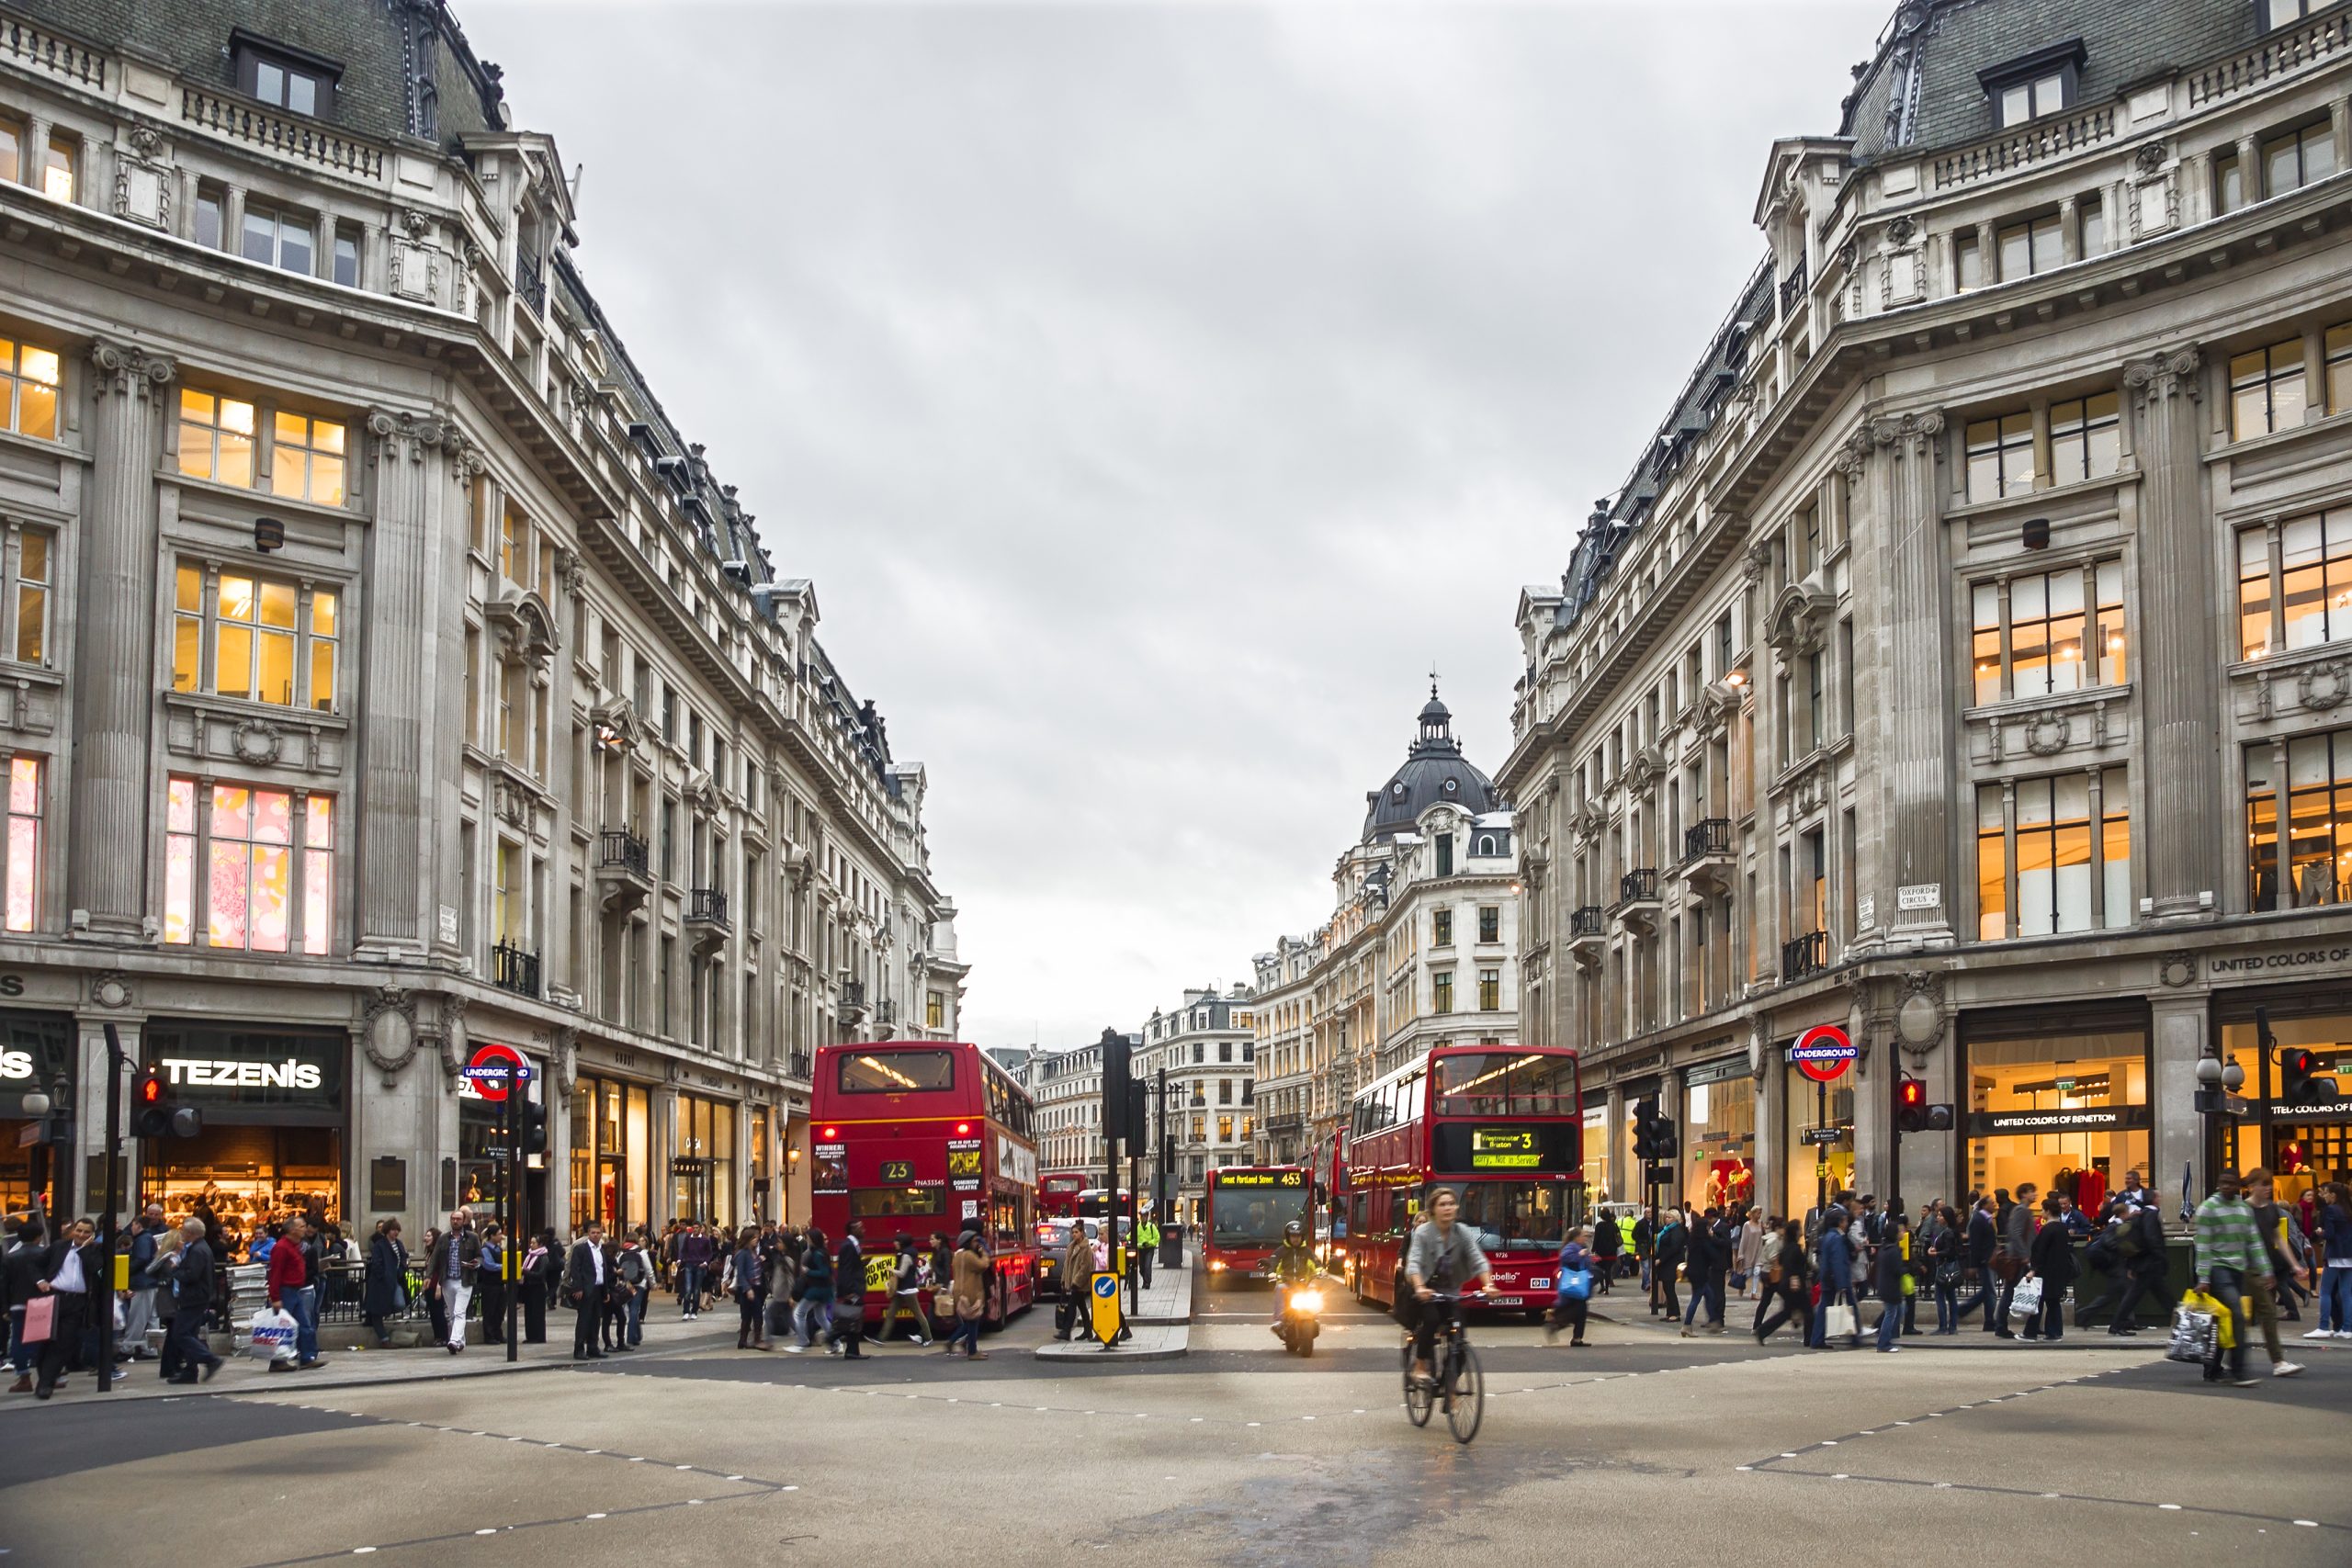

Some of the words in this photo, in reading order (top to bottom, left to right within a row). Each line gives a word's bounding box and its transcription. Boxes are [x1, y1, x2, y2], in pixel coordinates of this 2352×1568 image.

[1902, 888, 1931, 897] OXFORD
[1902, 896, 1927, 905] CIRCUS
[2211, 957, 2264, 973] UNITED
[2267, 951, 2325, 967] COLORS
[2330, 948, 2350, 962] OF
[1794, 1048, 1856, 1058] UNDERGROUND
[465, 1067, 528, 1077] UNDERGROND
[2335, 1103, 2349, 1111] OF
[1994, 1118, 2024, 1127] UNITED
[2025, 1115, 2058, 1125] COLORS
[2059, 1114, 2072, 1124] OF
[1521, 1133, 1532, 1149] 3
[1475, 1155, 1492, 1166] Sorry,
[1496, 1154, 1506, 1164] Not
[888, 1163, 908, 1179] 23
[1222, 1175, 1235, 1184] Great
[1237, 1175, 1258, 1184] Portland
[1259, 1175, 1274, 1184] Street
[1281, 1172, 1301, 1186] 453
[876, 1258, 893, 1271] NEW
[1489, 1272, 1516, 1280] abellio
[253, 1326, 294, 1337] SPORTS
